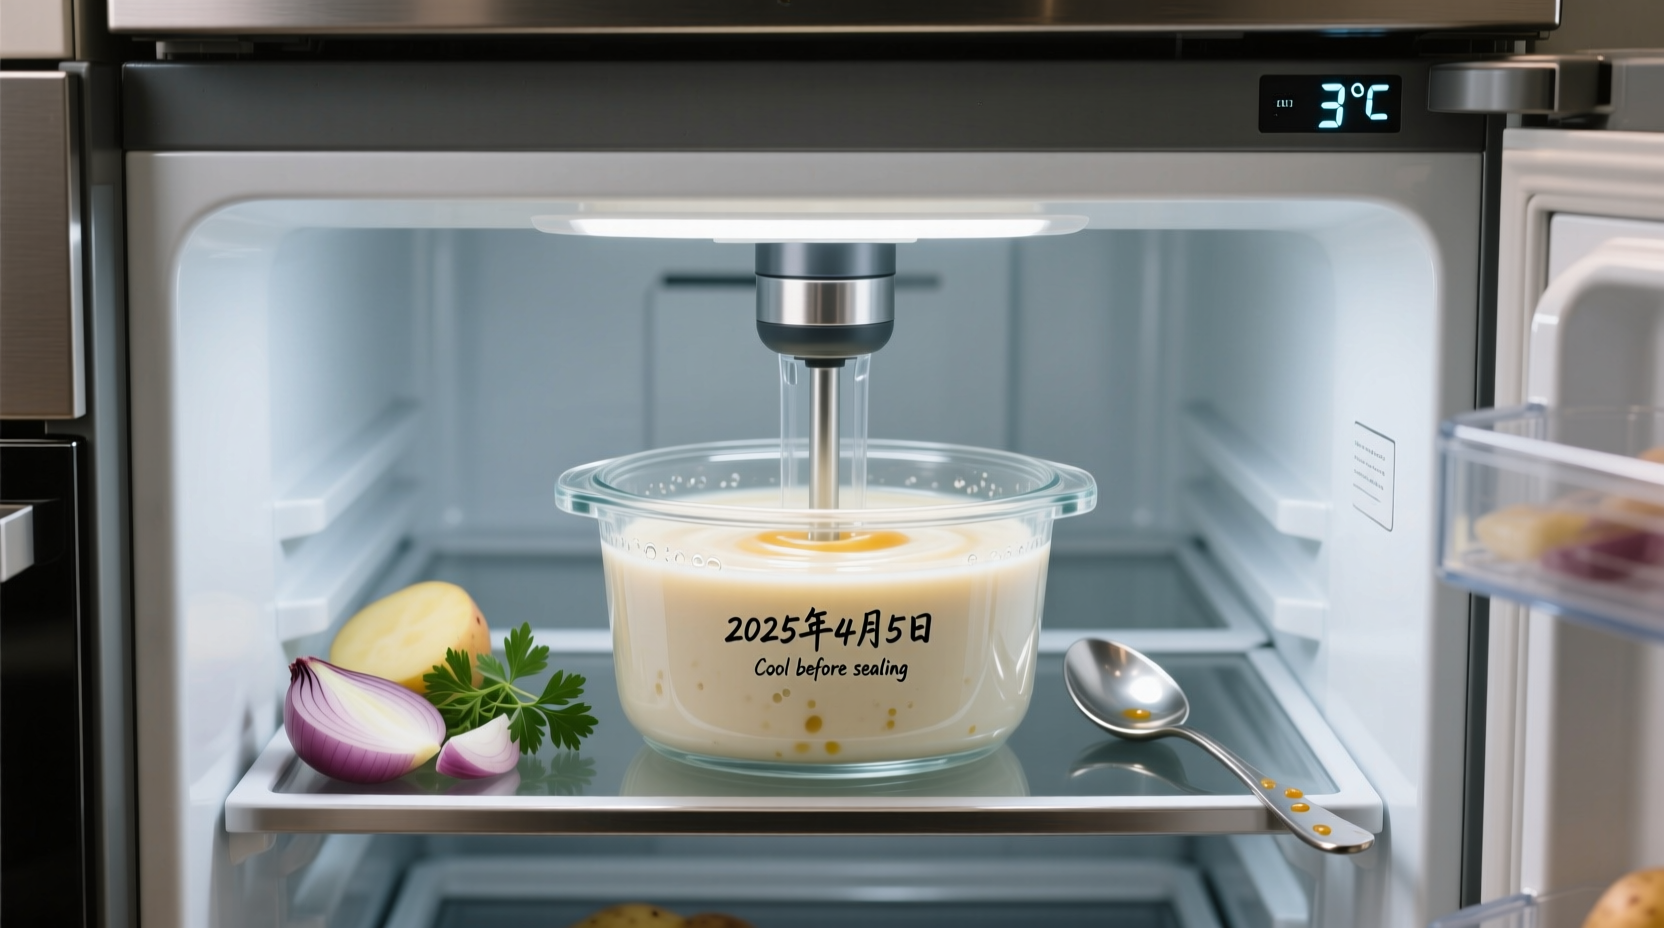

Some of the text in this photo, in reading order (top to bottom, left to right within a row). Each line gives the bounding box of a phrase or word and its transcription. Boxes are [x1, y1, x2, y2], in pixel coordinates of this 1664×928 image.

[1318, 82, 1390, 129] 3°C
[724, 606, 933, 653] 2025年4月5日
[754, 656, 909, 683] Cool before sealing
